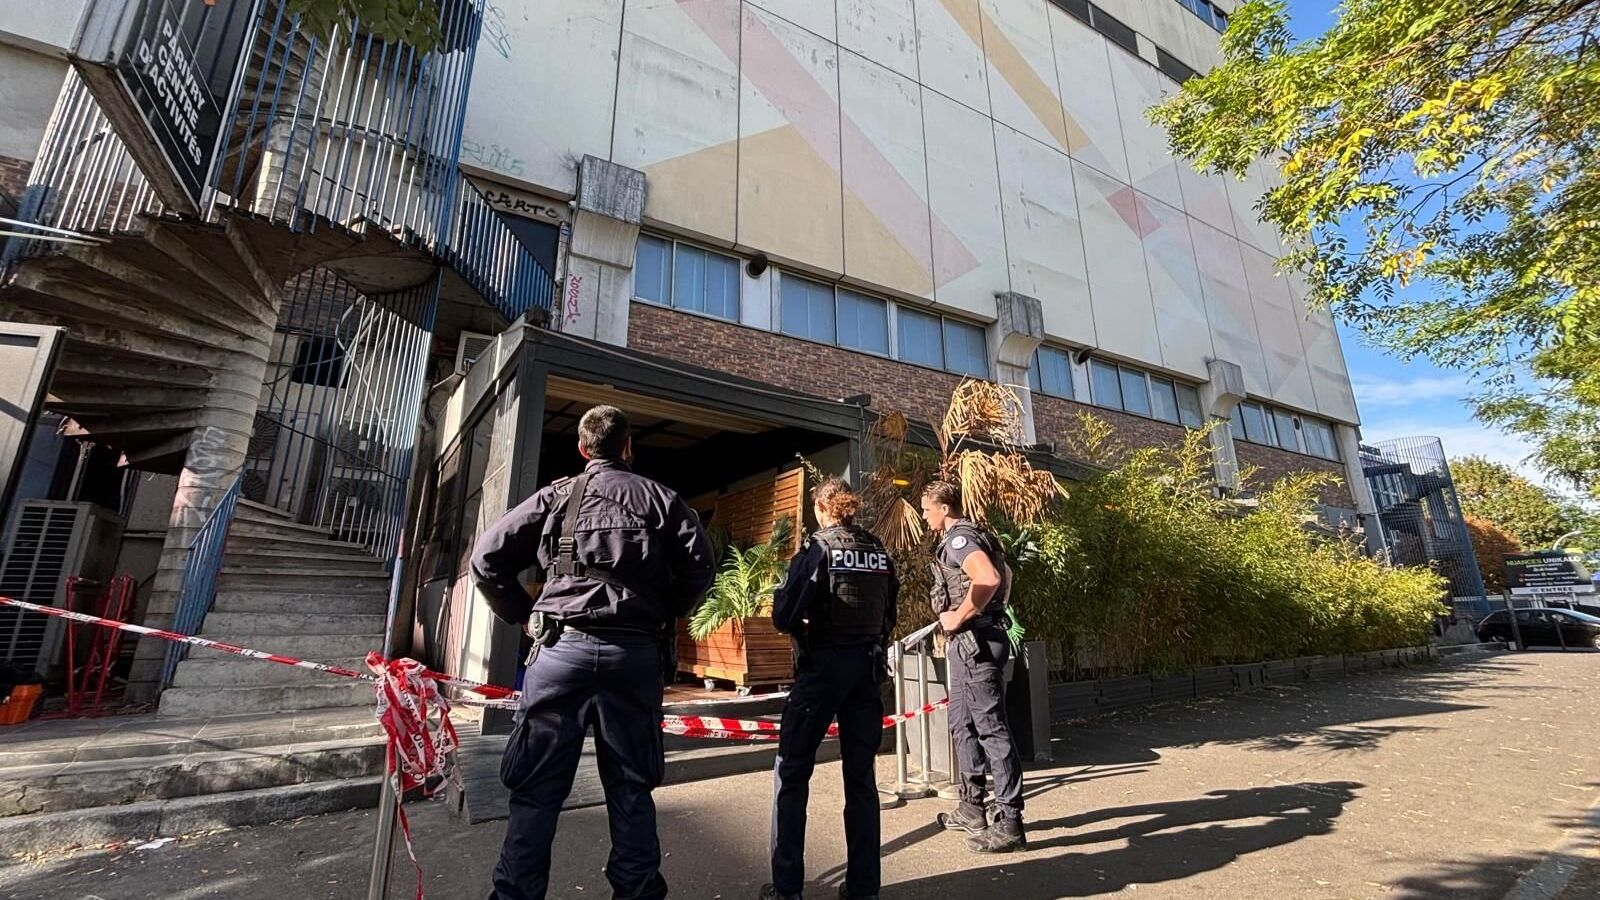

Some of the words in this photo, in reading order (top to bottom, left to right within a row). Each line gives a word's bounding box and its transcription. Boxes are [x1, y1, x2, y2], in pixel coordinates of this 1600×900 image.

[139, 40, 202, 166] D'ACTIVITÉS
[158, 45, 199, 130] CENTRE
[163, 20, 205, 109] PARIVRY
[832, 550, 888, 570] POLICE
[1506, 558, 1542, 566] NUANCES
[1543, 556, 1581, 564] UNIKALO
